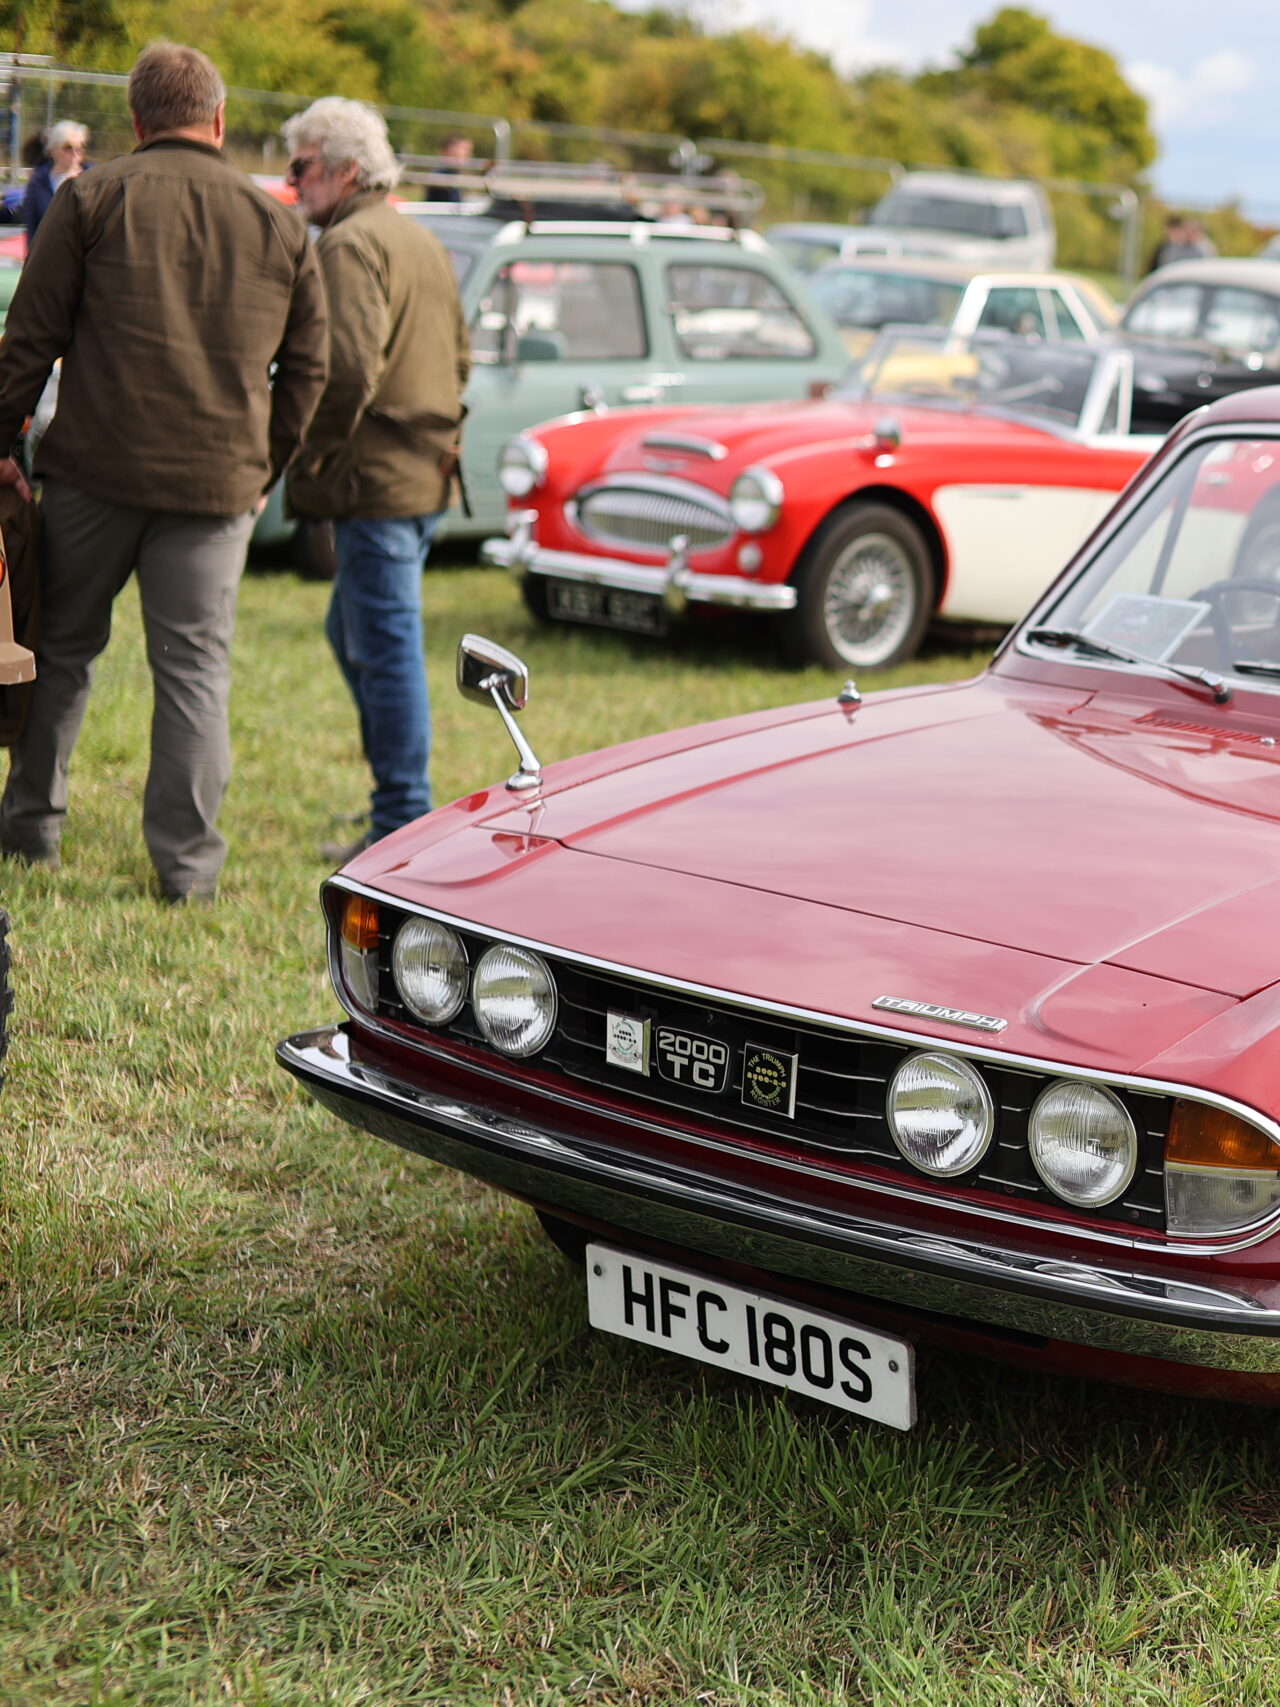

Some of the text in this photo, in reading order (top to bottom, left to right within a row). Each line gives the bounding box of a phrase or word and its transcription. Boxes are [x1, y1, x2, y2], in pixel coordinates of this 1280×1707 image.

[881, 998, 1000, 1028] TRIUMPH
[659, 1031, 726, 1065] 2000
[666, 1052, 715, 1088] TC
[747, 1053, 787, 1077] THE TRIUMPH
[750, 1089, 781, 1107] REGISTER
[622, 1265, 873, 1403] HFC 180S
